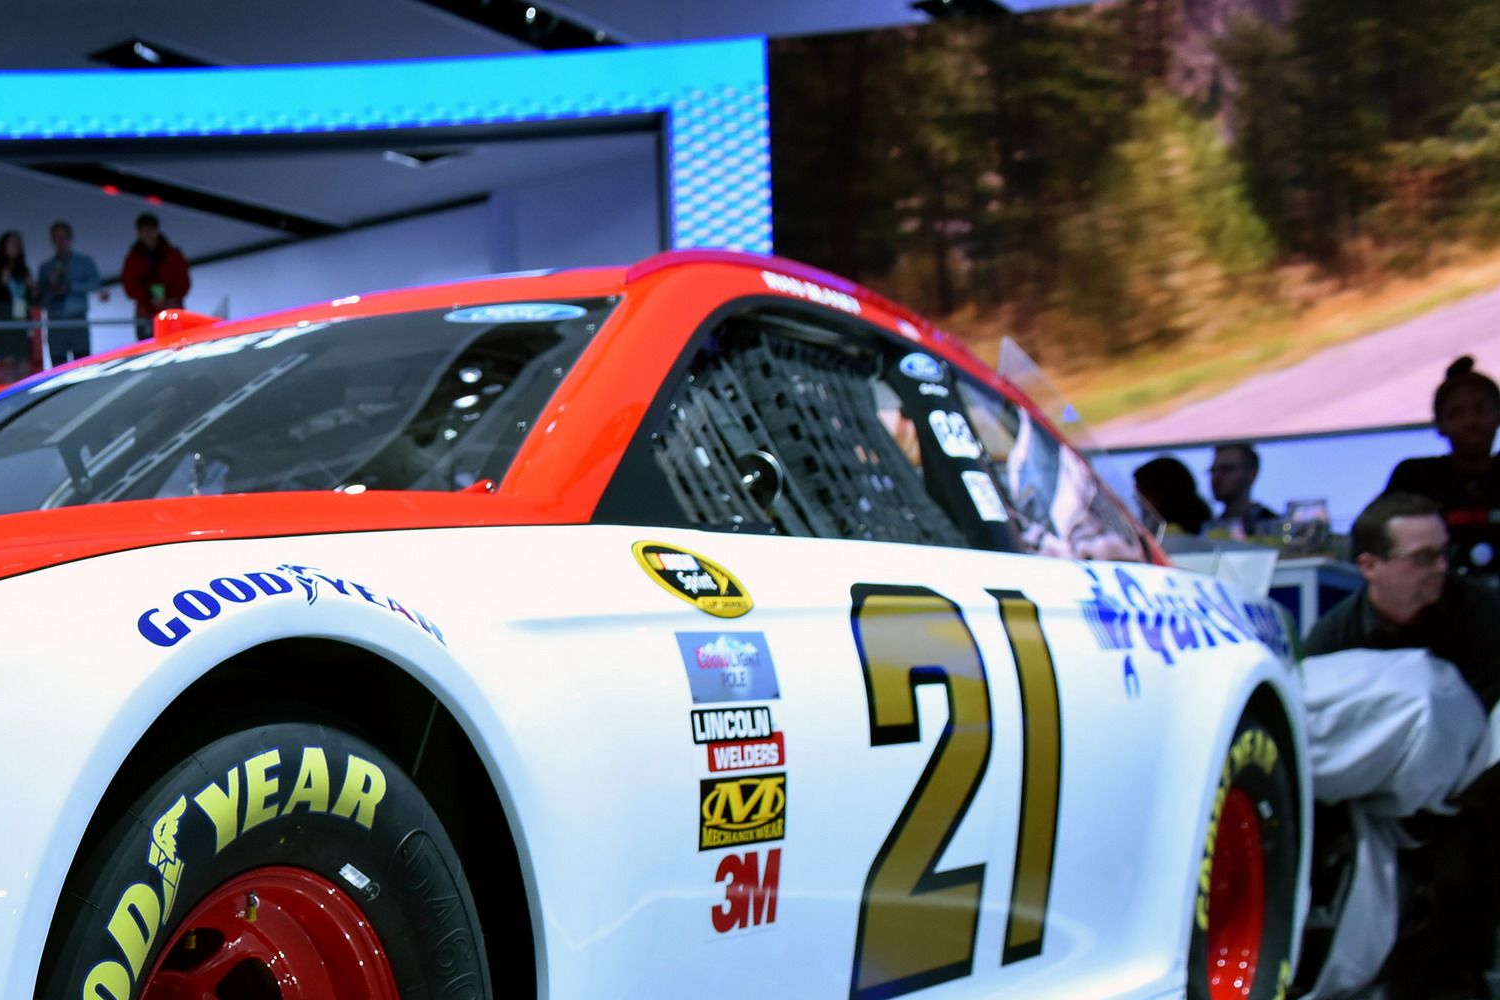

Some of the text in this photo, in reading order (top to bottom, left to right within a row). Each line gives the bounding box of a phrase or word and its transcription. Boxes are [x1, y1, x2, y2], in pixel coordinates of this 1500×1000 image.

[721, 671, 748, 688] POLE
[693, 708, 771, 742] LINCOLN
[714, 743, 779, 770] WELDERS
[711, 848, 782, 934] 3M
